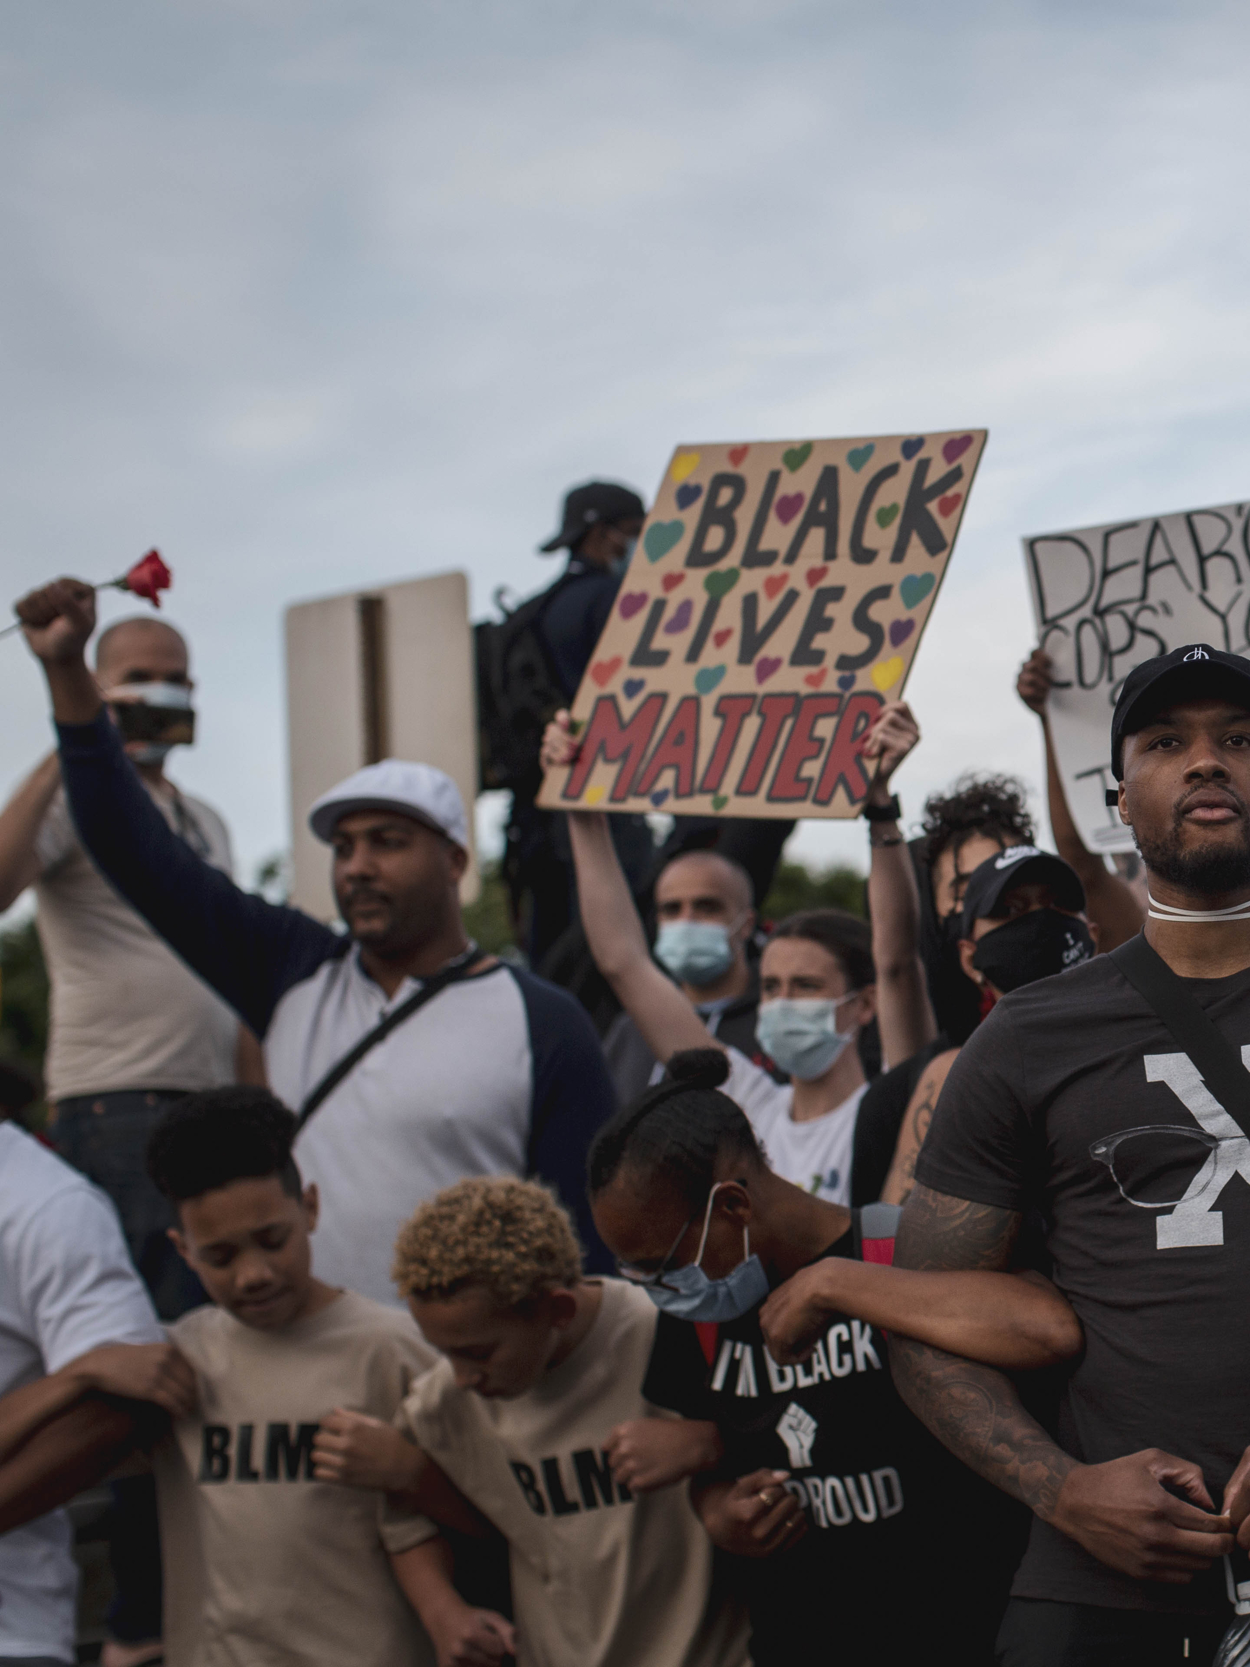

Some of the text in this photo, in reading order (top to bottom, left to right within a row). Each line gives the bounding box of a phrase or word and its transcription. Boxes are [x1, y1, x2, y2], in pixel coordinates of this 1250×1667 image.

[684, 457, 965, 569] BLACK
[1028, 508, 1242, 625] DEAR
[628, 583, 894, 672] LIVES
[561, 690, 886, 807] MATTER
[761, 1318, 883, 1395] BLACK
[201, 1423, 320, 1484] BLM
[510, 1448, 635, 1517] BLM
